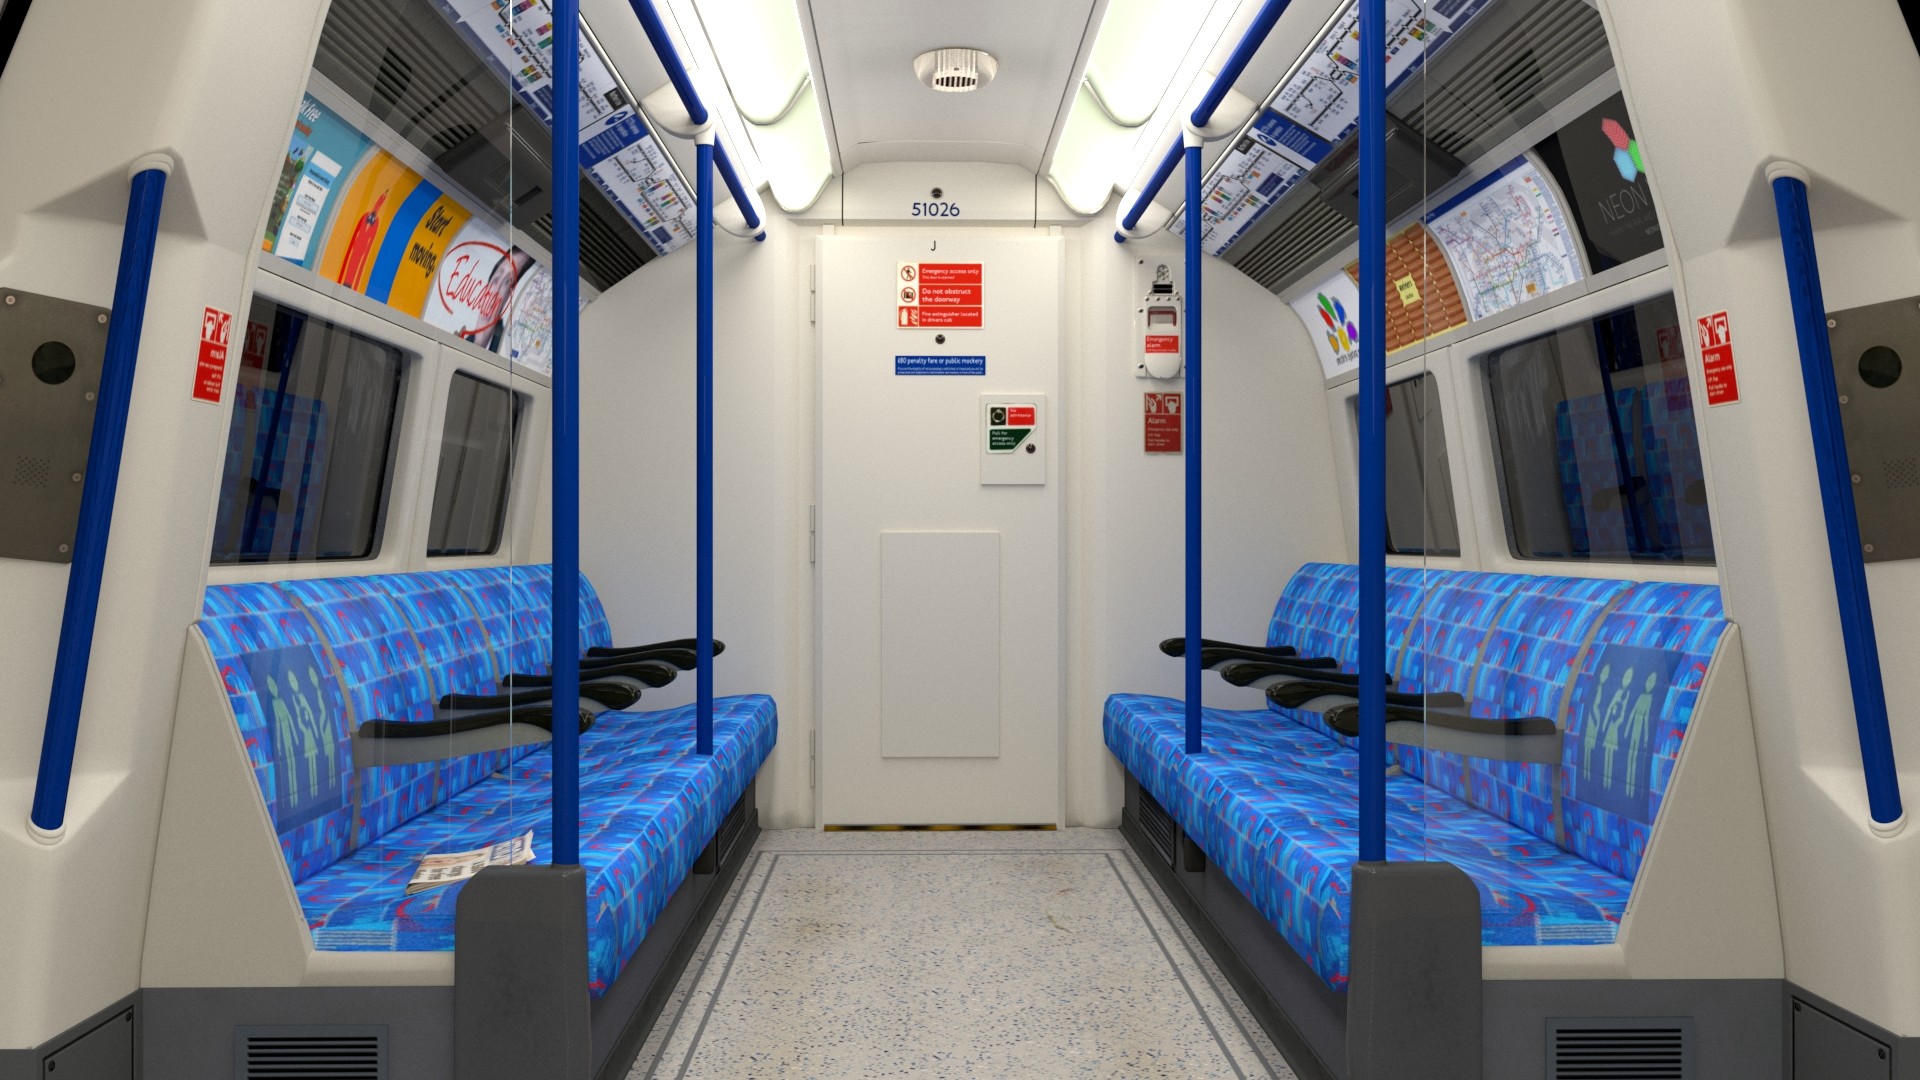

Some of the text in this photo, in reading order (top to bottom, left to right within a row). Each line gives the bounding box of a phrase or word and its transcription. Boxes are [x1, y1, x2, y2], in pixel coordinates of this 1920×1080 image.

[1598, 182, 1649, 225] NEON
[911, 202, 961, 217] 51026
[425, 205, 453, 238] Start
[930, 240, 937, 252] J
[408, 242, 438, 279] moving.
[921, 267, 948, 275] Emergency
[446, 254, 503, 319] Education
[921, 287, 932, 295] Do
[944, 287, 972, 295] obstruct
[933, 296, 961, 304] doorway
[907, 357, 927, 365] penalty
[944, 357, 961, 365] public
[961, 357, 984, 365] mockery
[1704, 353, 1721, 364] Alarm
[1147, 417, 1168, 425] Alarm
